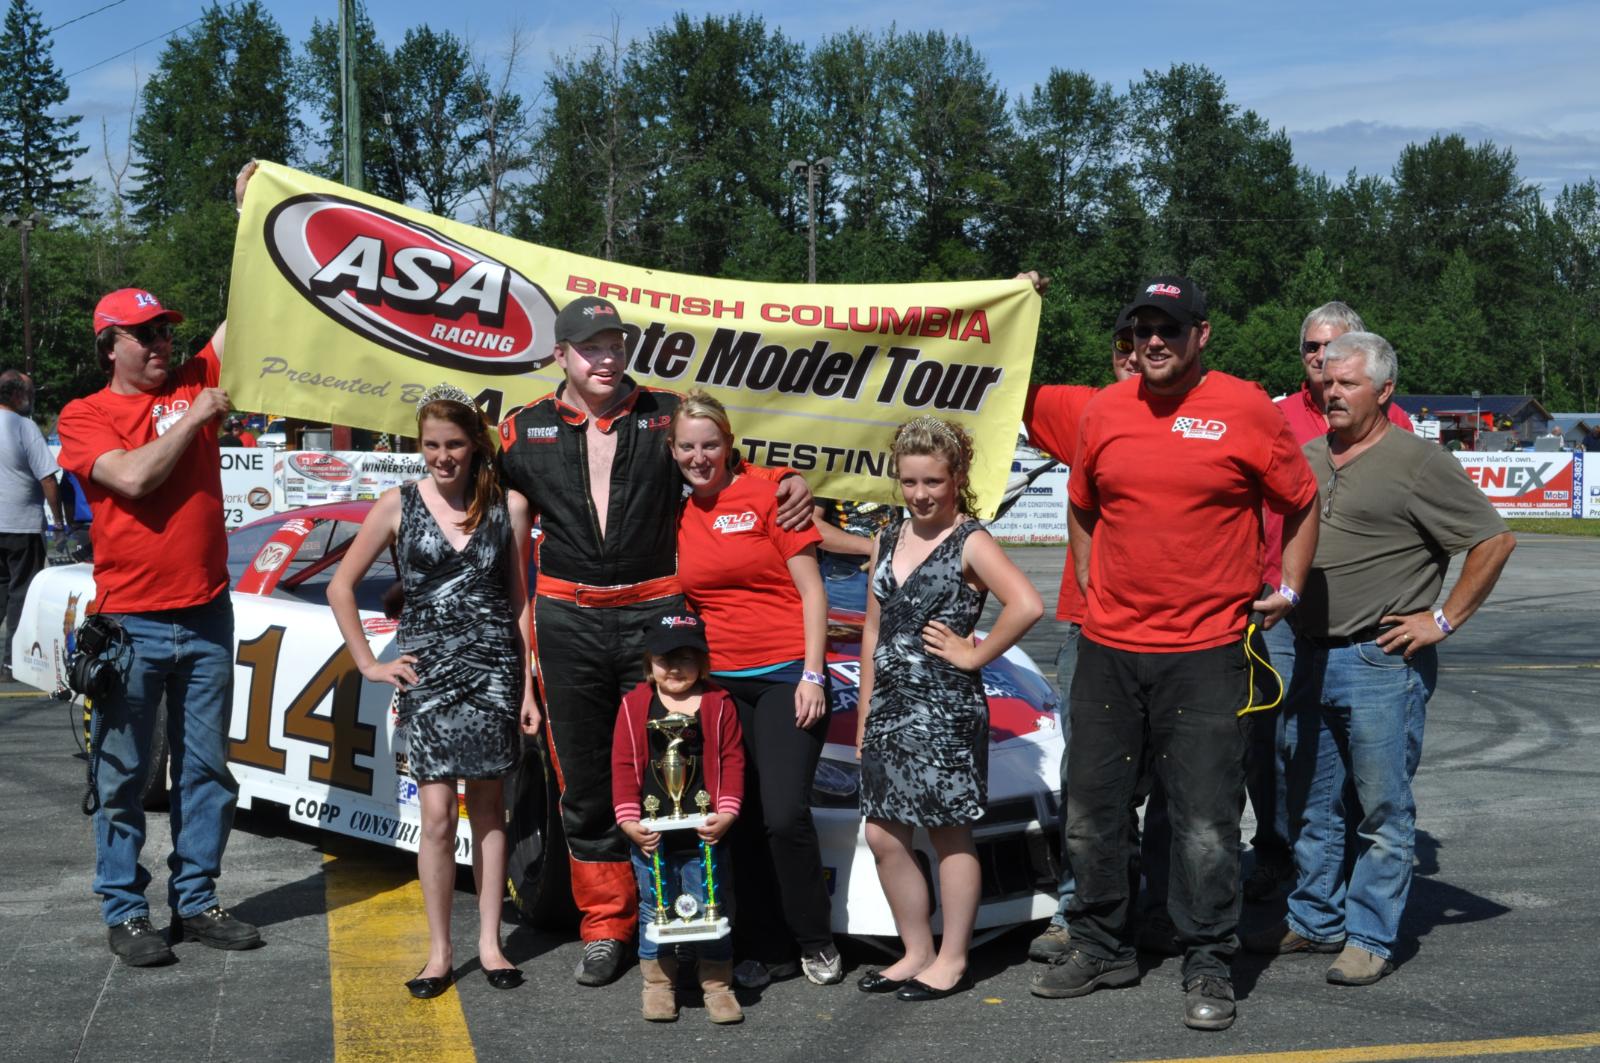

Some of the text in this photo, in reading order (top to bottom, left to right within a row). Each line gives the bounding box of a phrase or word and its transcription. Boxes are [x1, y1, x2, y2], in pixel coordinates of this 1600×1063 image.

[311, 235, 510, 322] ASA
[135, 293, 158, 307] 14
[565, 274, 991, 344] BRITISH COLUMBIA
[430, 323, 515, 353] RACING
[260, 356, 426, 404] Presented B
[622, 320, 1003, 413] ate Model Tour
[406, 464, 429, 474] CIRC
[1545, 491, 1568, 499] Mobil
[226, 623, 377, 797] 14
[295, 797, 341, 823] COPP
